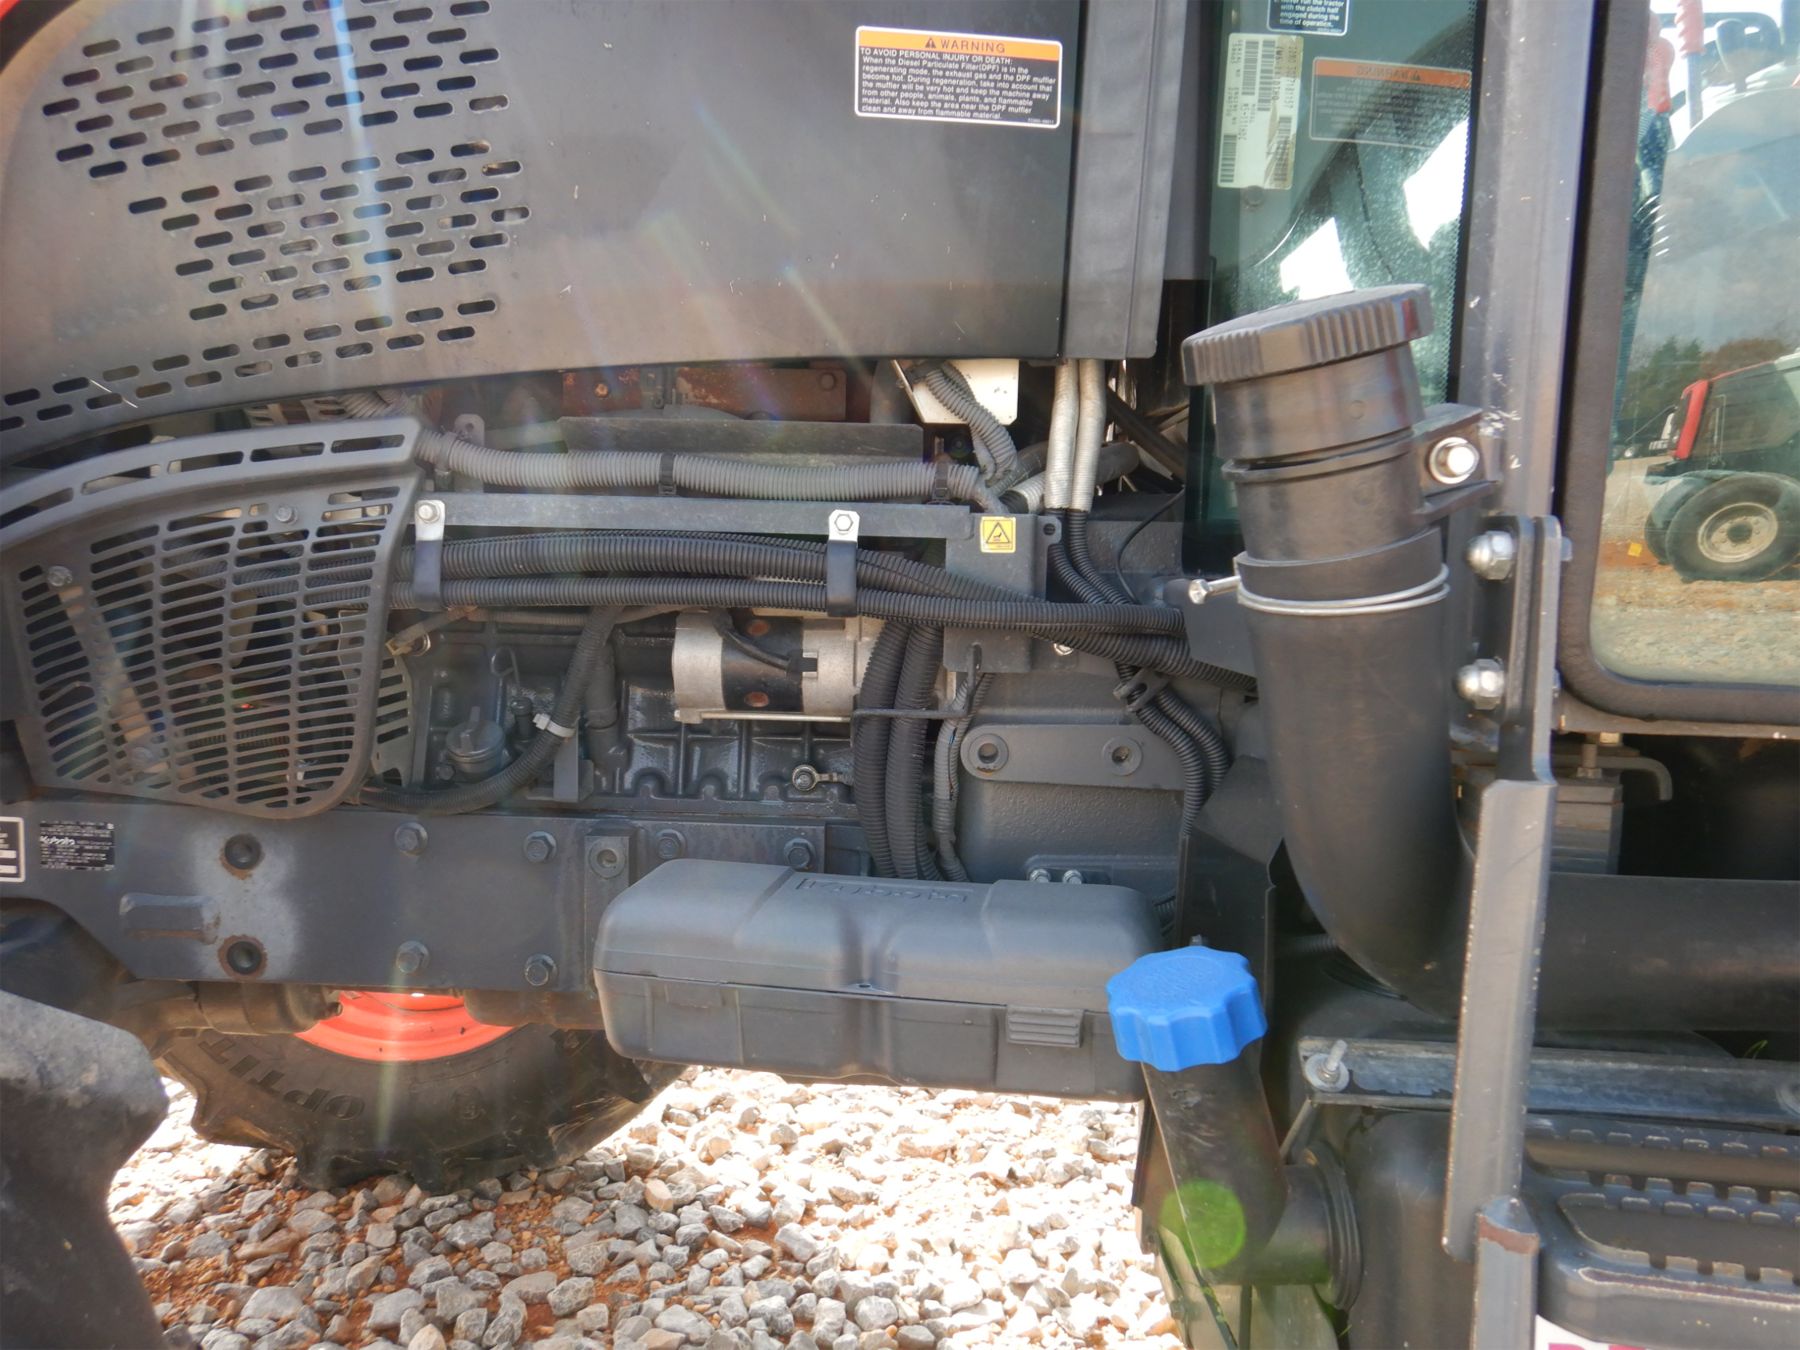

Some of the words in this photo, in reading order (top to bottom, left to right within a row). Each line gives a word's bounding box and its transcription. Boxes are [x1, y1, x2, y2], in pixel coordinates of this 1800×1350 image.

[941, 39, 1006, 52] WARNING
[862, 55, 882, 63] When
[922, 60, 958, 68] Particulate
[961, 62, 999, 71] Filter(DPF)
[873, 48, 896, 56] AVOID
[899, 50, 940, 59] PERSONAL
[942, 53, 969, 61] INJURY
[985, 56, 1012, 64] DEATH:
[862, 65, 906, 74] regenerating
[945, 69, 972, 77] exhaust
[862, 72, 889, 80] become
[907, 75, 930, 84] During
[932, 77, 977, 87] regeneration,
[1011, 82, 1036, 90] account
[875, 81, 899, 89] muffler
[970, 87, 986, 96] keep
[862, 96, 891, 104] material.
[911, 99, 928, 108] keep
[880, 89, 897, 97] other
[900, 91, 925, 100] people,
[958, 95, 981, 104] plants,
[998, 97, 1032, 105] flammable
[935, 109, 970, 117] flammable
[972, 111, 1001, 119] material.
